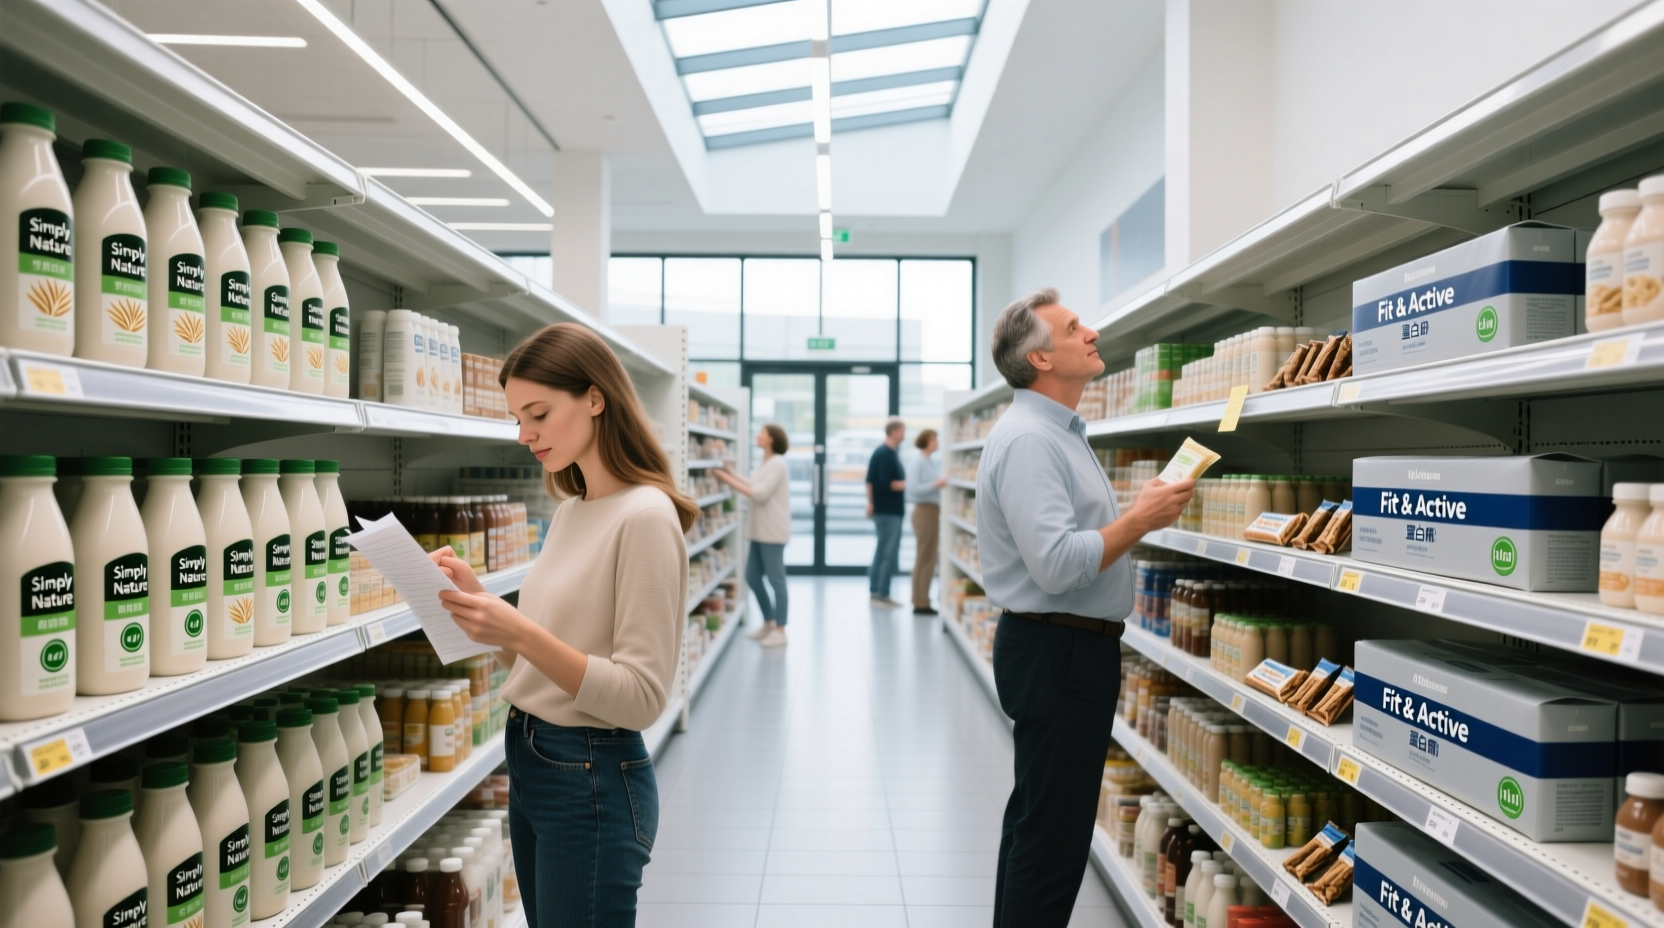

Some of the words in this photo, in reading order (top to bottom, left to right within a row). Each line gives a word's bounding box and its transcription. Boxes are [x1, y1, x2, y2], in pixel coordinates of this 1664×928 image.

[30, 217, 70, 241] Simply
[30, 235, 72, 256] Nature
[1378, 299, 1394, 323] Fit
[1396, 297, 1407, 318] &
[1408, 286, 1455, 315] Active
[1381, 491, 1399, 514] Fit
[1401, 493, 1412, 516] &
[1415, 494, 1467, 519] Active
[31, 572, 73, 592] Simply
[113, 564, 147, 580] Simply
[113, 581, 148, 595] Nature
[31, 592, 74, 610] Nature
[1383, 687, 1402, 715] Fit
[1403, 697, 1414, 720] &
[1417, 702, 1469, 743] Active
[1381, 880, 1399, 913] Fit
[1401, 898, 1412, 924] &
